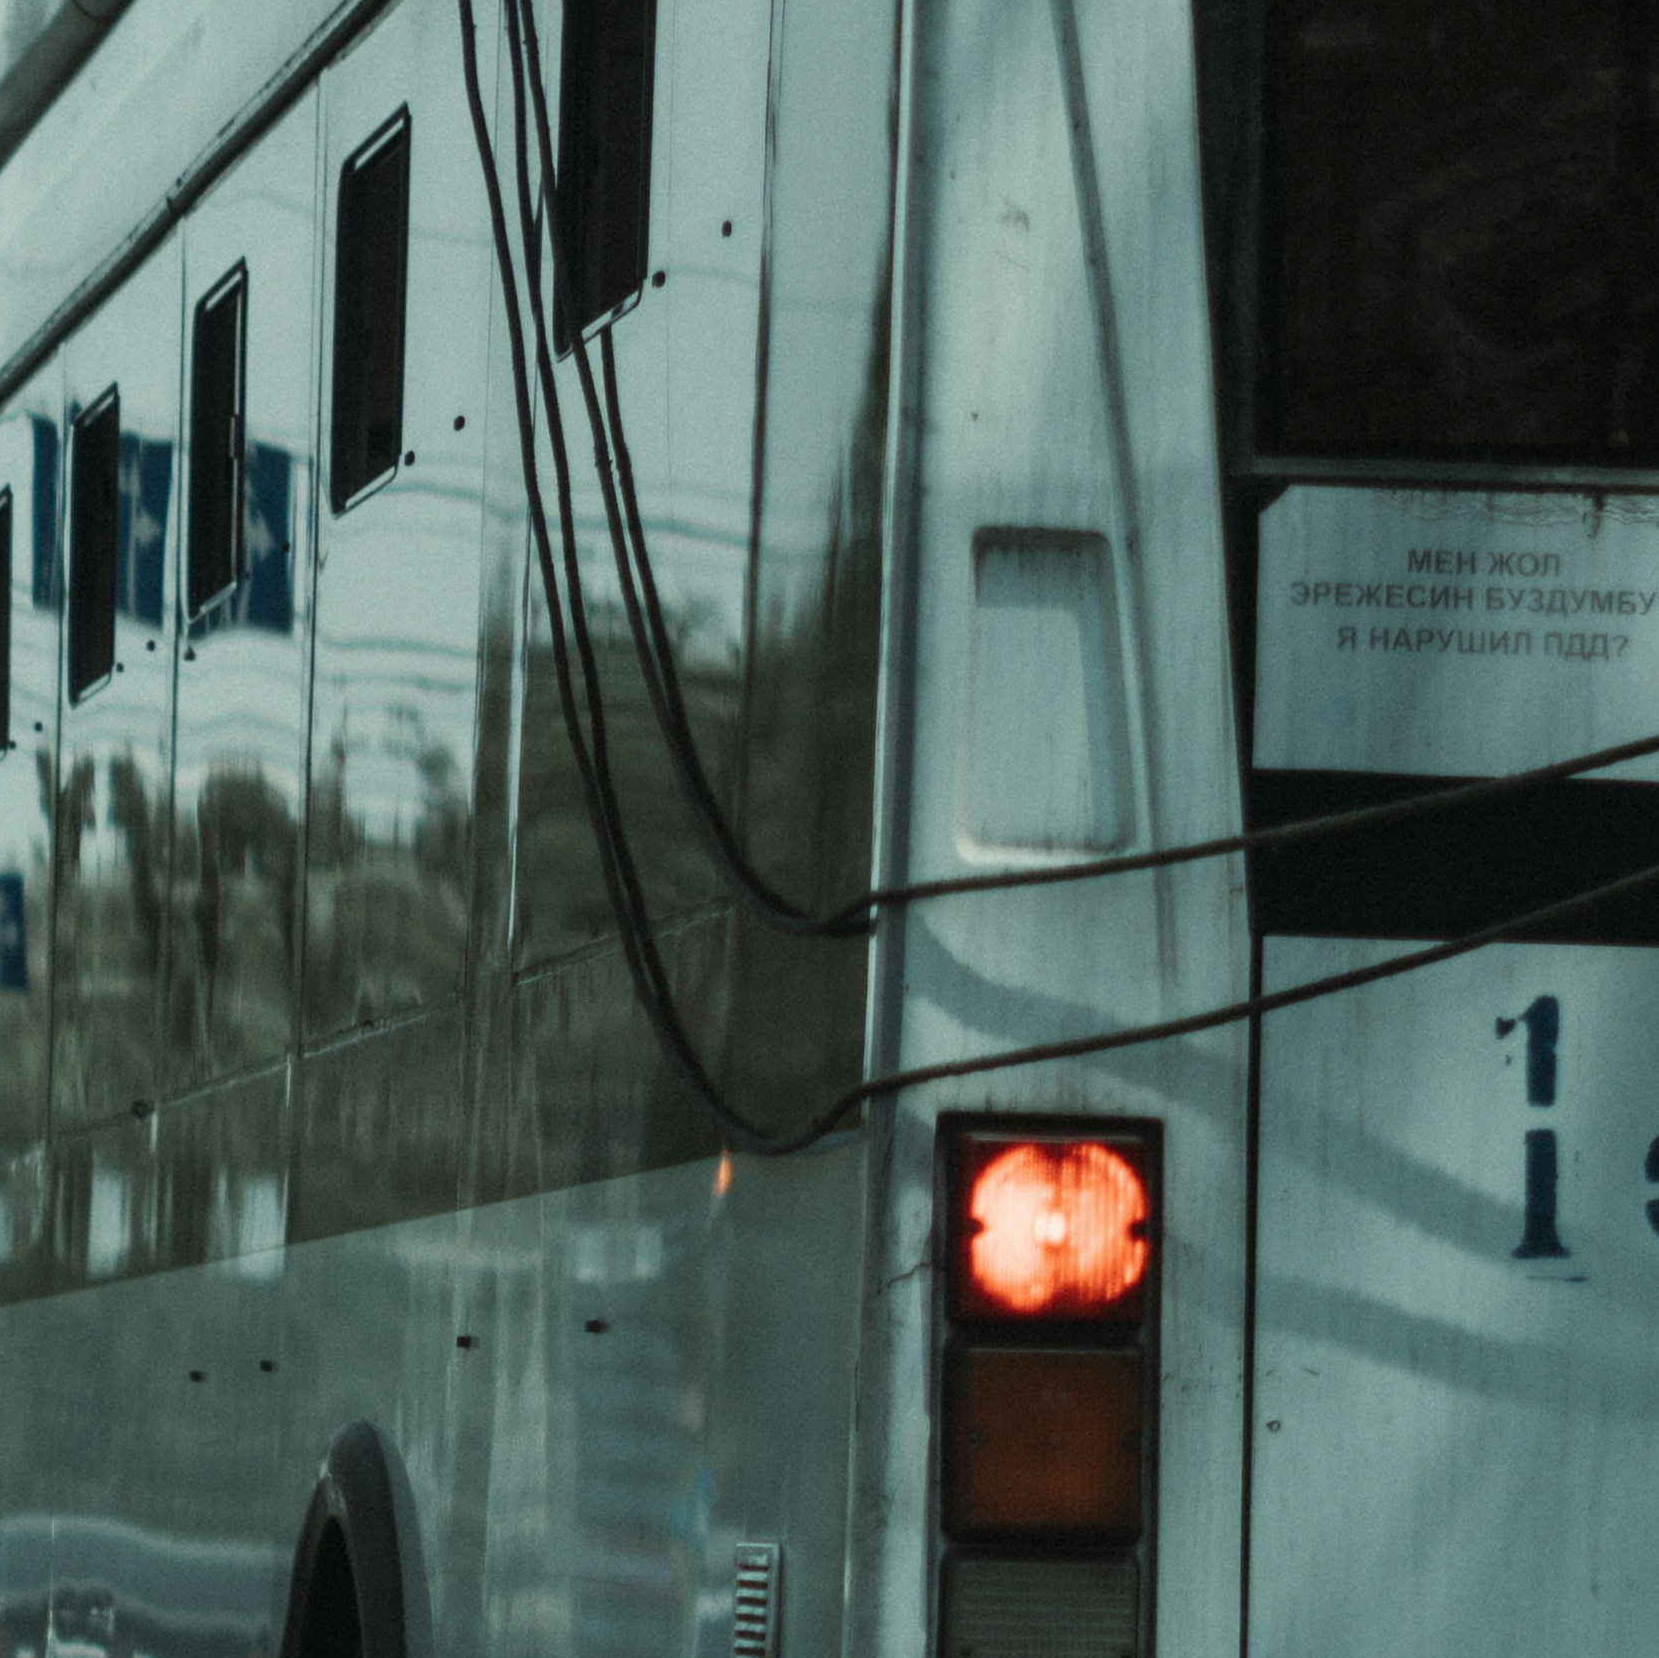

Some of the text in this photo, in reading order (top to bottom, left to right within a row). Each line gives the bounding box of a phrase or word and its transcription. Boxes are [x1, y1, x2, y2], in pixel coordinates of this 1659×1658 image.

[1407, 549, 1563, 577] МЕН ЖОЛ
[1289, 581, 1658, 616] ЭРЕЖЕСИН БУЗДУМБУ
[1336, 626, 1631, 661] Я НАРУШИЛ ПДД?
